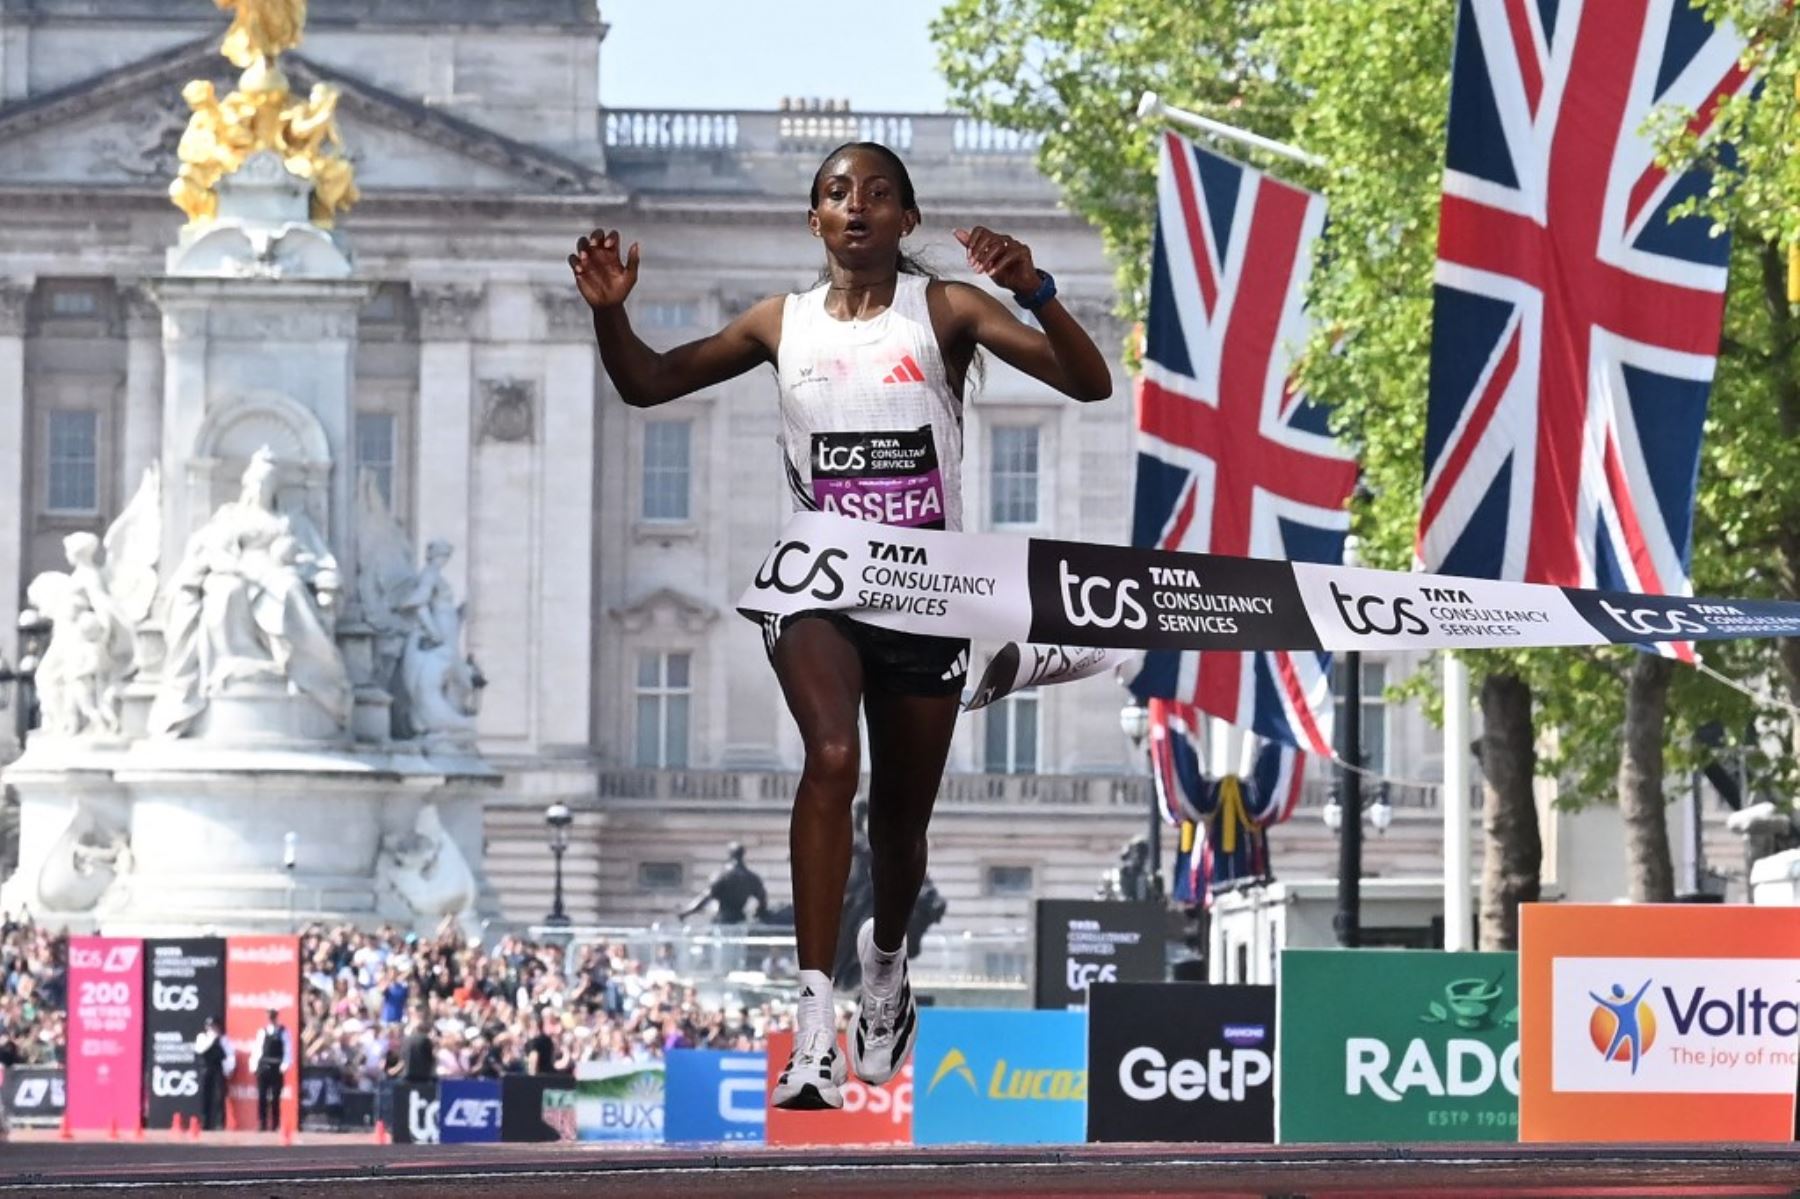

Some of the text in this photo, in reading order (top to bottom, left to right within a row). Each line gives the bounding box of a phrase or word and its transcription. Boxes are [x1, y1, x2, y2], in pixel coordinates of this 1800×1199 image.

[870, 439, 900, 448] TATA
[818, 441, 866, 471] tcs
[871, 460, 916, 470] SERVICES
[823, 486, 941, 523] ASSEFA
[868, 541, 928, 566] TATA
[862, 565, 996, 596] CONSULTANCY
[1149, 567, 1201, 588] TATA
[856, 590, 949, 616] SERVICES
[1059, 559, 1149, 630] tcs
[1153, 591, 1273, 615] CONSULTANCY
[1419, 587, 1474, 604] TATA
[1330, 581, 1430, 635] tcs
[1428, 607, 1551, 624] CONSULTANCY
[1599, 600, 1709, 635] tcs
[1687, 603, 1746, 616] TATA
[1157, 614, 1239, 633] SERVICES
[1438, 624, 1522, 636] SERVICES
[80, 982, 129, 1005] 200
[153, 981, 199, 1011] tcs
[1670, 1047, 1705, 1065] The
[1710, 1047, 1740, 1068] joy
[1745, 1047, 1763, 1065] of
[153, 1066, 199, 1096] tcs
[1119, 1047, 1272, 1101] GetP
